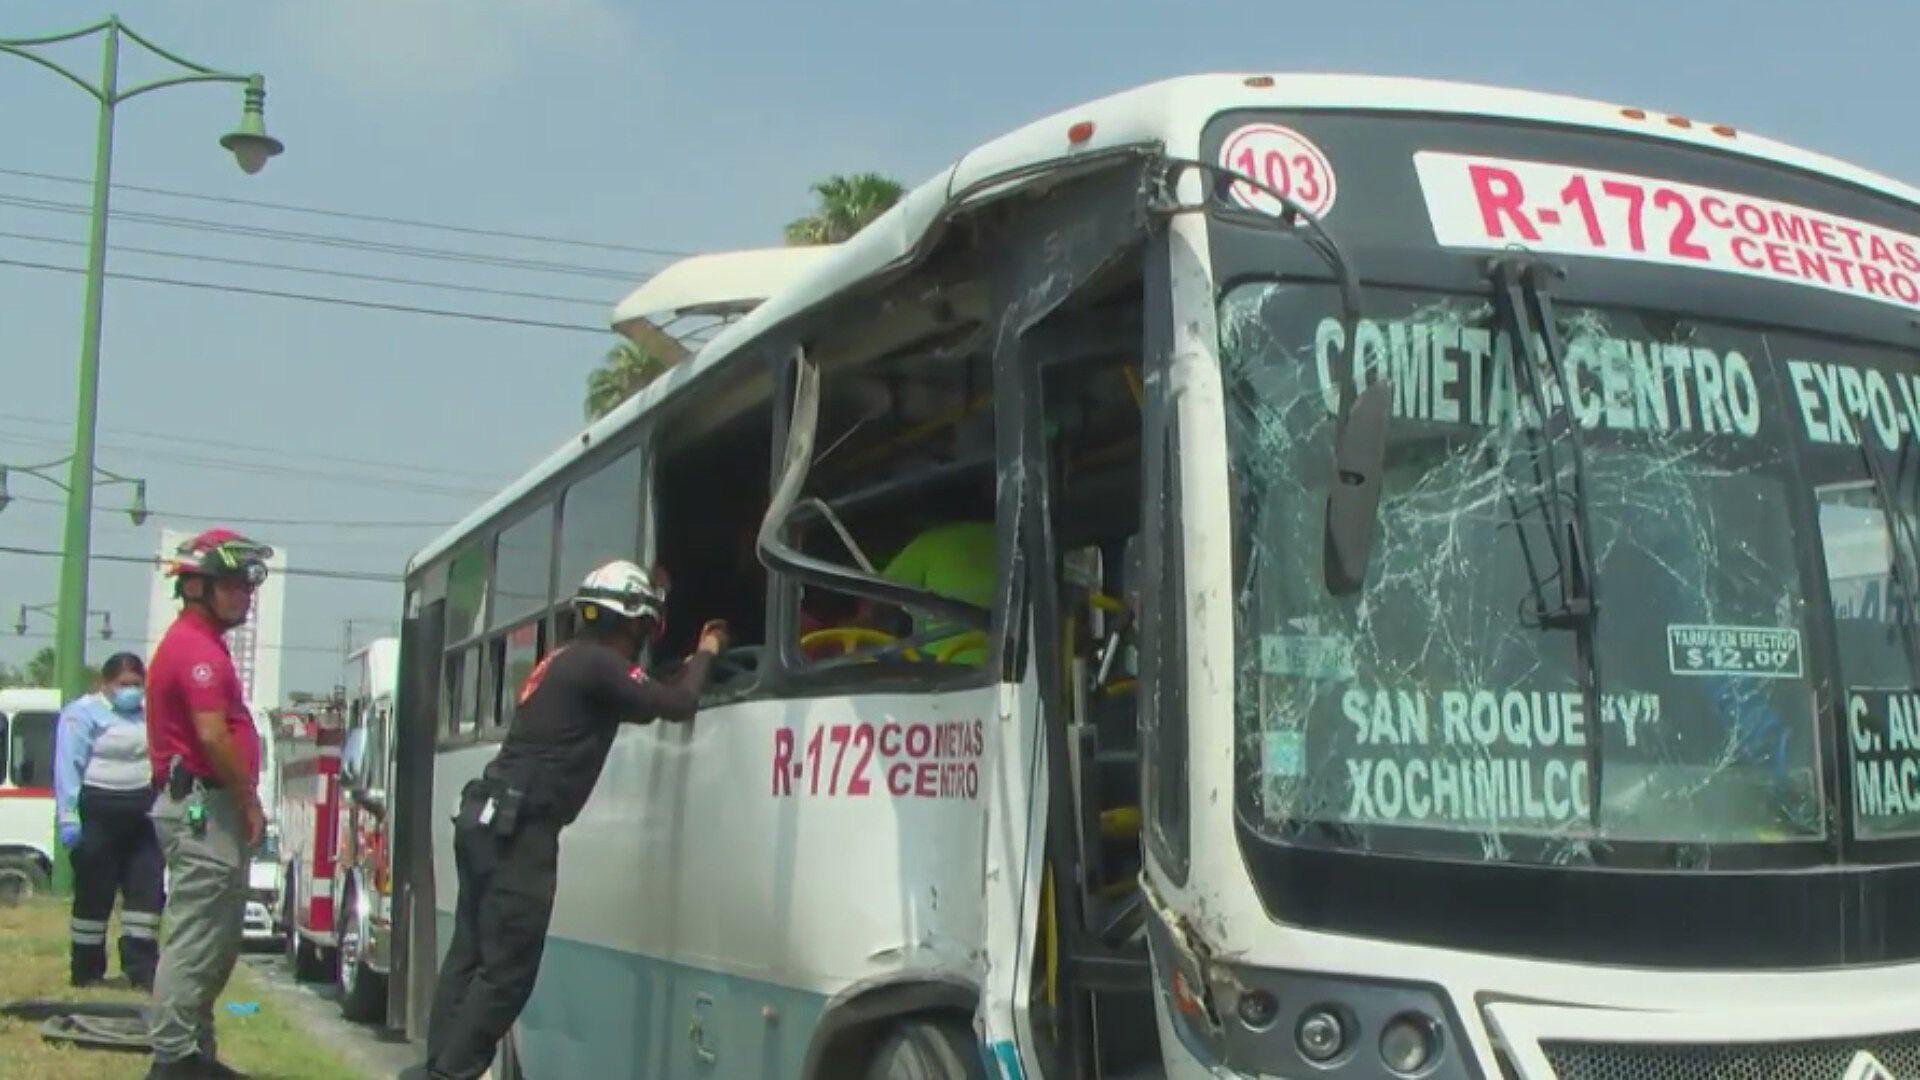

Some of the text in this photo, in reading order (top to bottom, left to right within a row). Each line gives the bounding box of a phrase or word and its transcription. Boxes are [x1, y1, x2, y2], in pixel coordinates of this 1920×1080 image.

[1237, 148, 1319, 202] 103
[1468, 164, 1920, 273] R-172 COMETAS
[1730, 236, 1919, 304] CENTRO
[1342, 691, 1429, 745] SAN
[1443, 690, 1587, 749] ROQUE
[1850, 694, 1882, 753] C.
[772, 718, 983, 796] R-172 COMETAS
[887, 761, 978, 798] CENTRO
